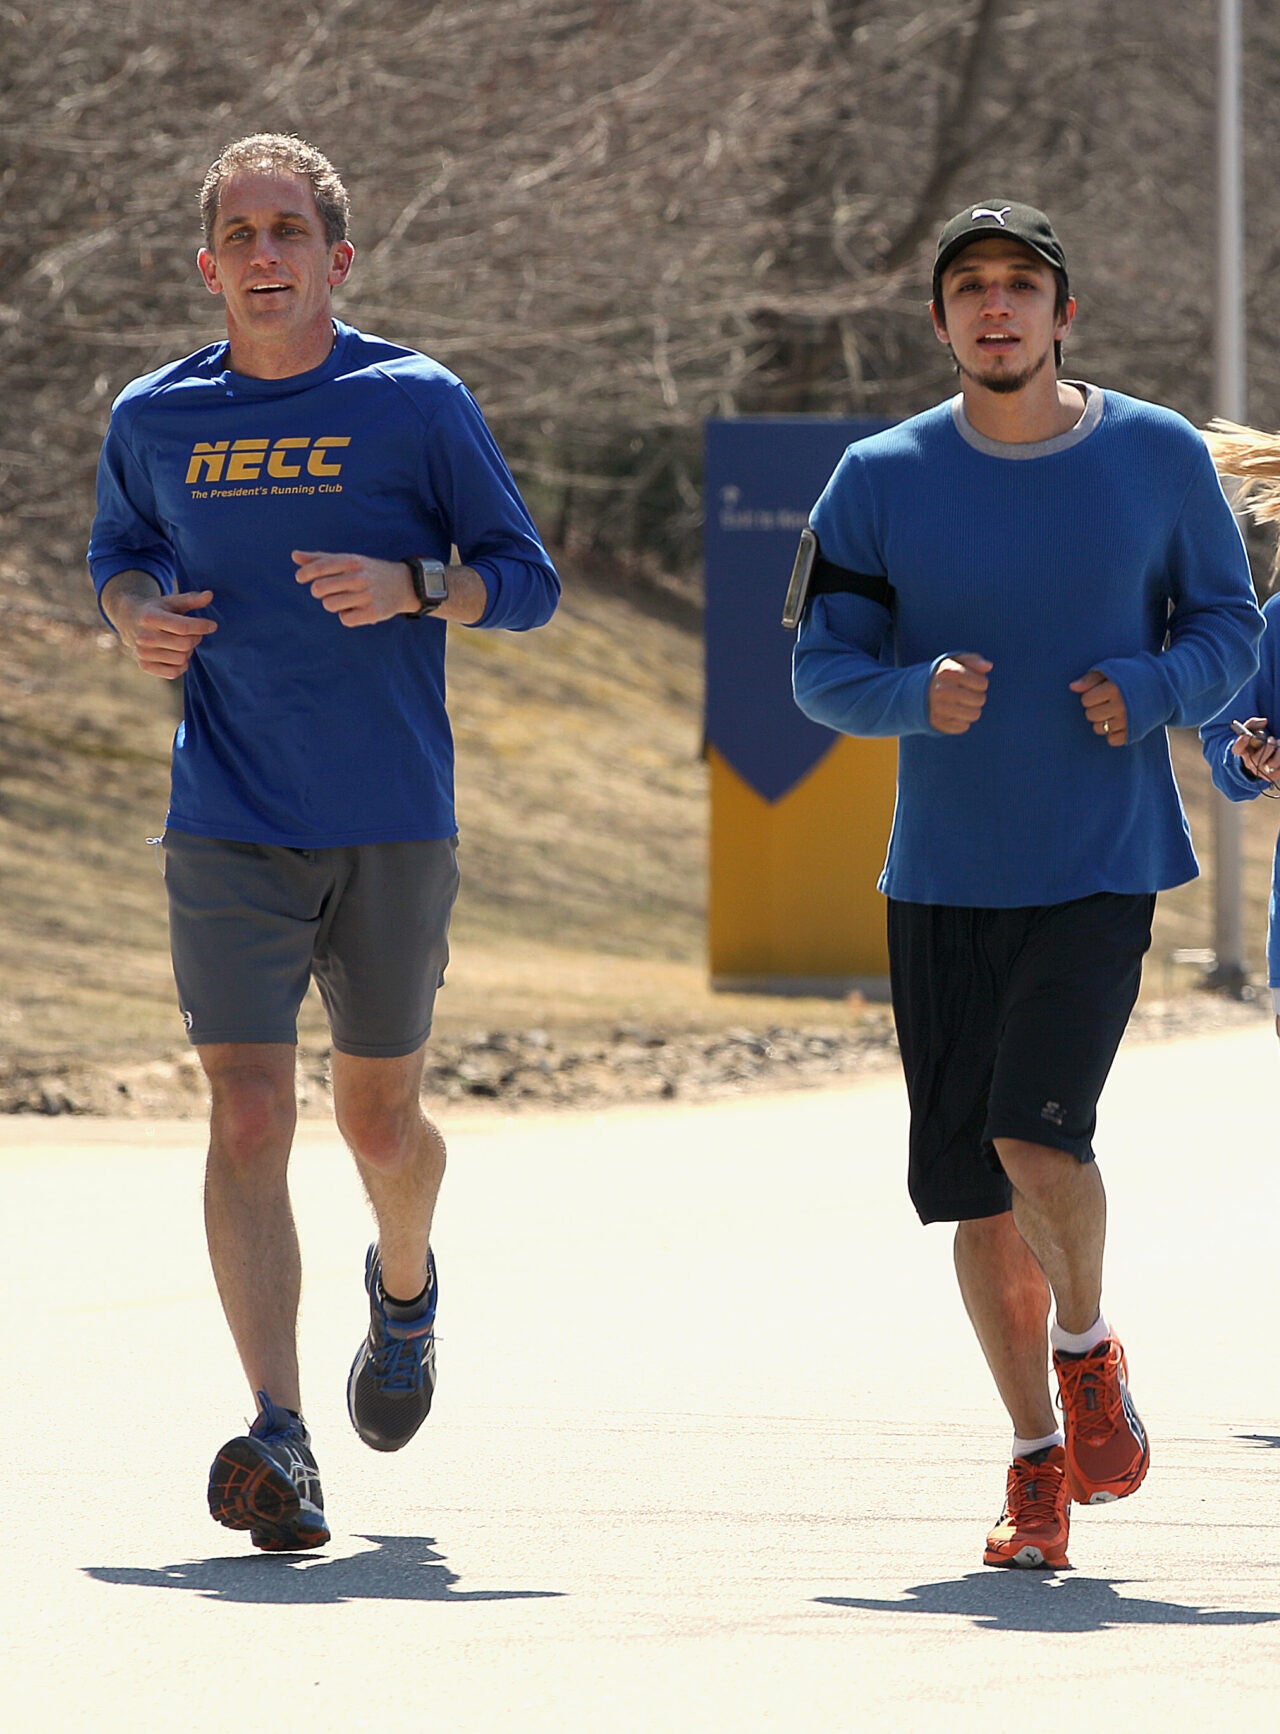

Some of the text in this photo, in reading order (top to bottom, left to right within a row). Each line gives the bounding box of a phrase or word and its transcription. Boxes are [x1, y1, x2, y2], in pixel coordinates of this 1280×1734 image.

[185, 436, 352, 484] NECC
[191, 483, 343, 500] The President's Running Club
